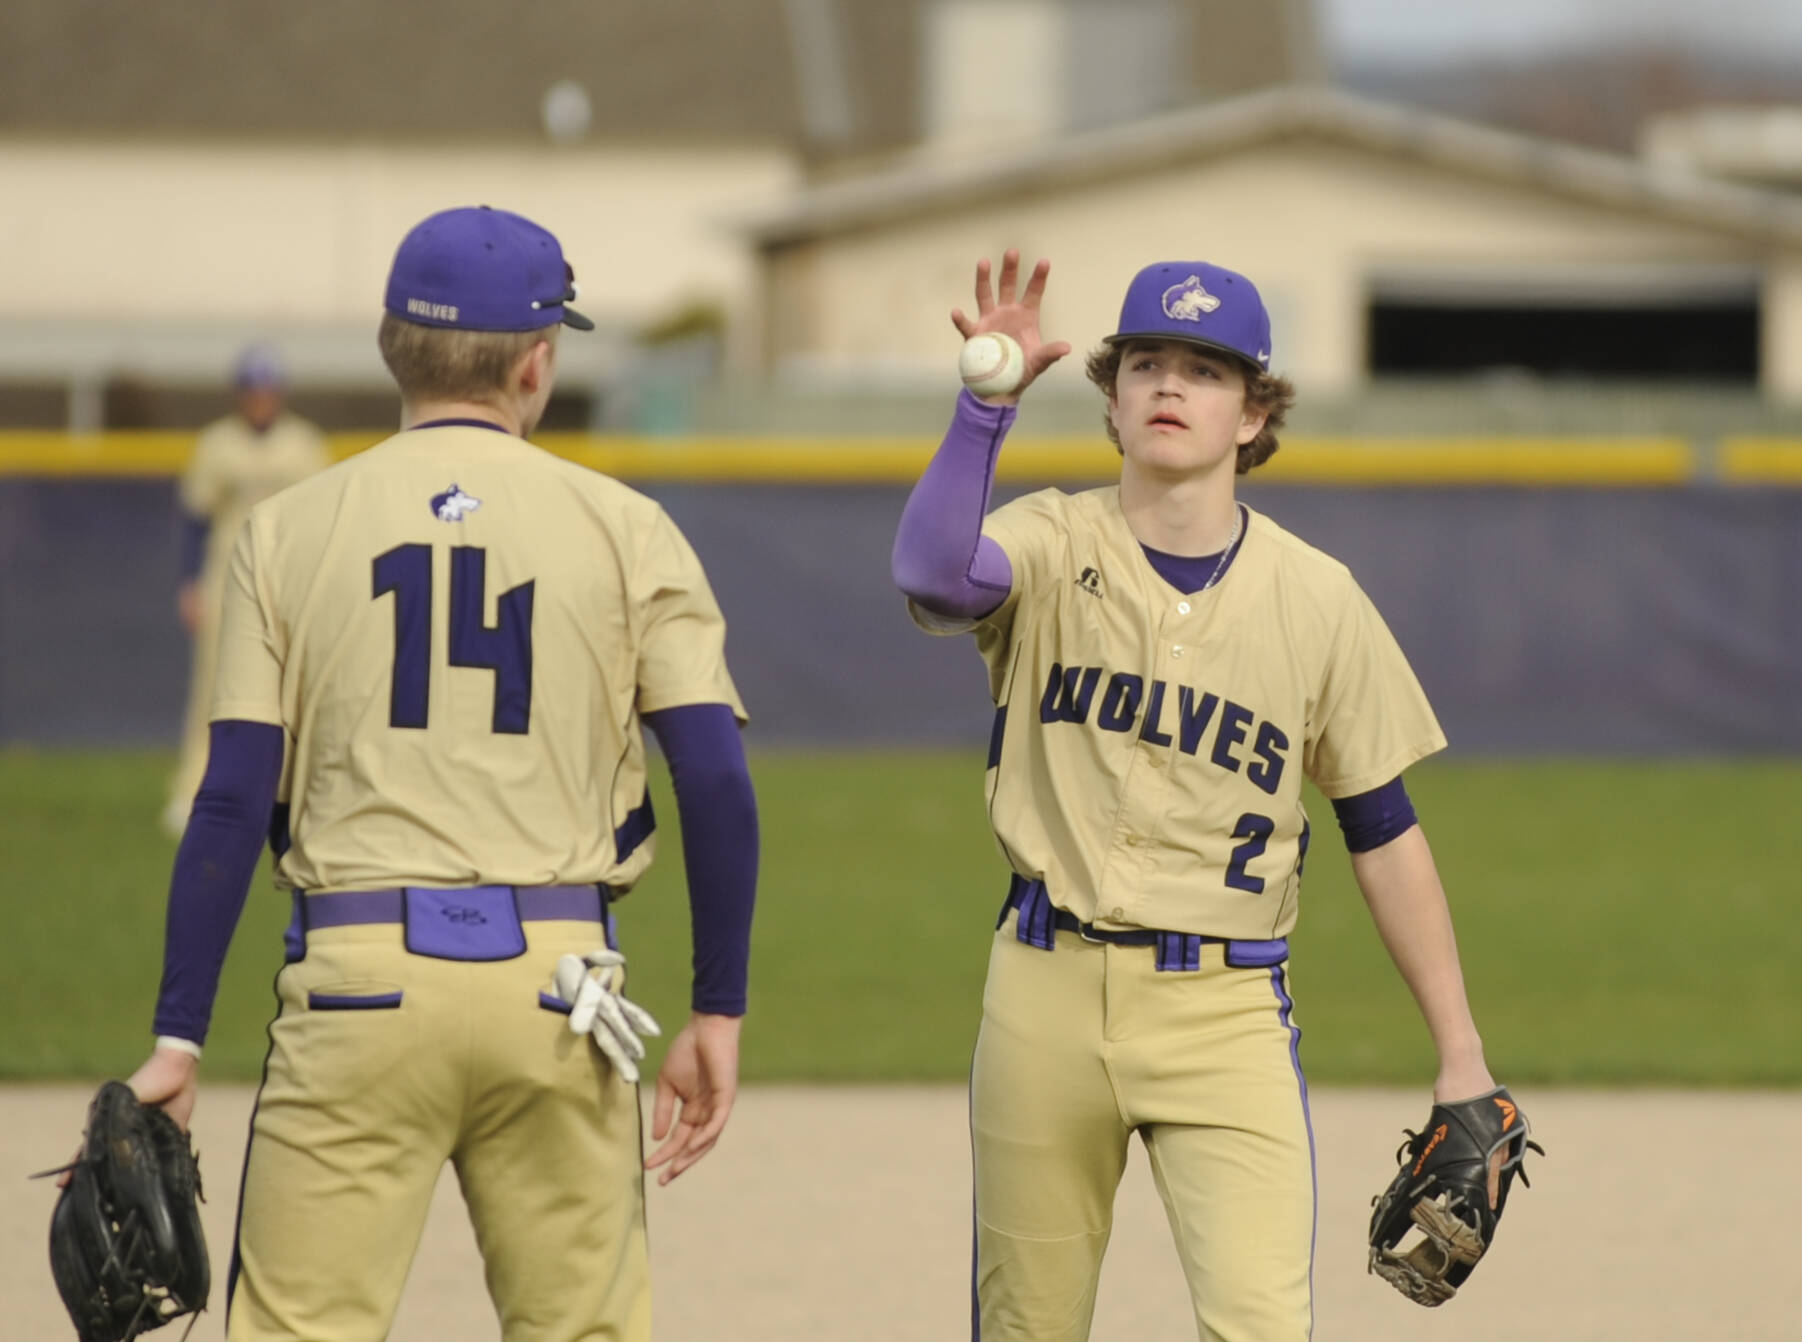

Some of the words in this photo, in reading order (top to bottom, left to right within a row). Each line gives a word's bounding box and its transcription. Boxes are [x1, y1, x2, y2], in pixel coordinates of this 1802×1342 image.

[407, 298, 459, 322] WOLVES
[371, 542, 535, 735] 14
[1040, 662, 1290, 795] WOLVES
[1224, 812, 1275, 895] 2
